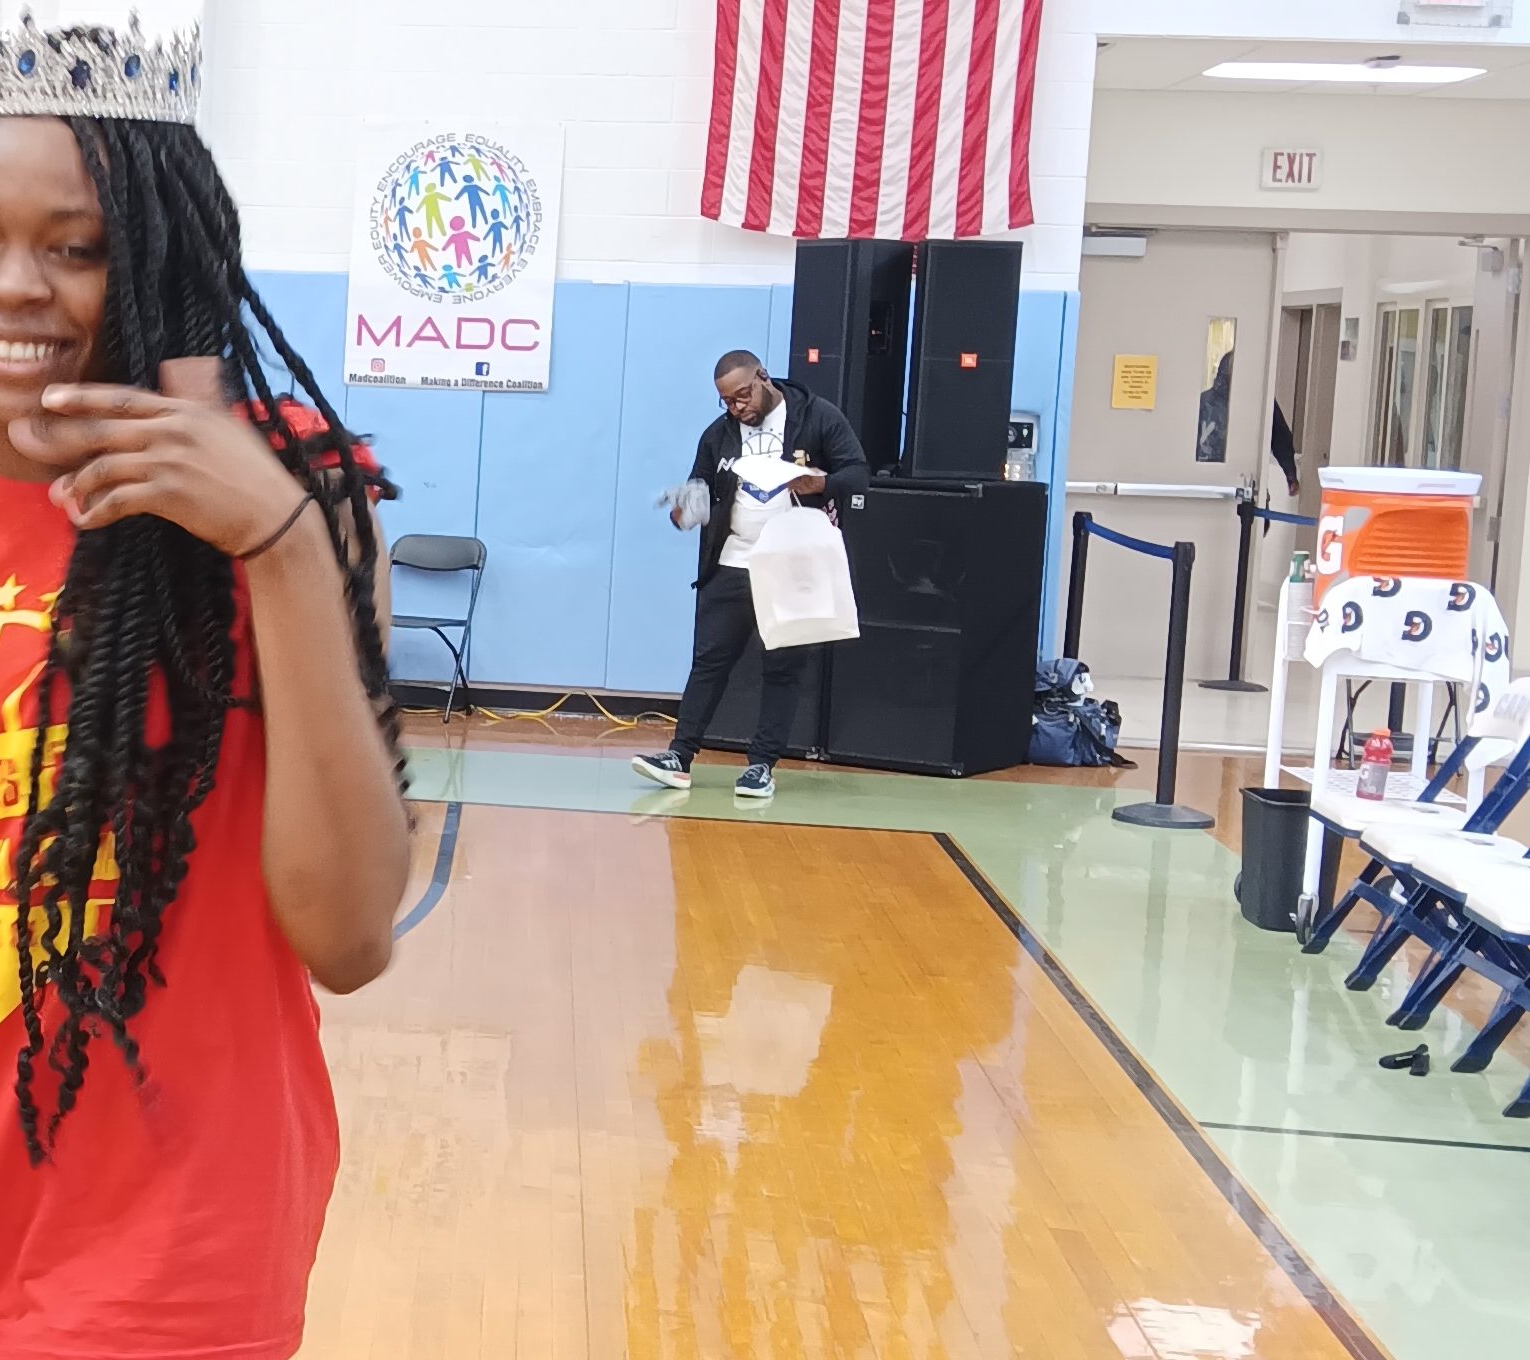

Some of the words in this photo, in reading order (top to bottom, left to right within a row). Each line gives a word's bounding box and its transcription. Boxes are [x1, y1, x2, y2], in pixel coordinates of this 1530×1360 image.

[377, 132, 457, 192] ENCOURAGE
[465, 133, 529, 174] EQUALITY
[1272, 151, 1317, 184] EXIT
[370, 196, 380, 250] EQUITY
[525, 179, 543, 256] EMBRACE
[377, 254, 443, 304] EMPOWER
[452, 259, 528, 304] EVERYONE
[356, 313, 540, 351] MADC
